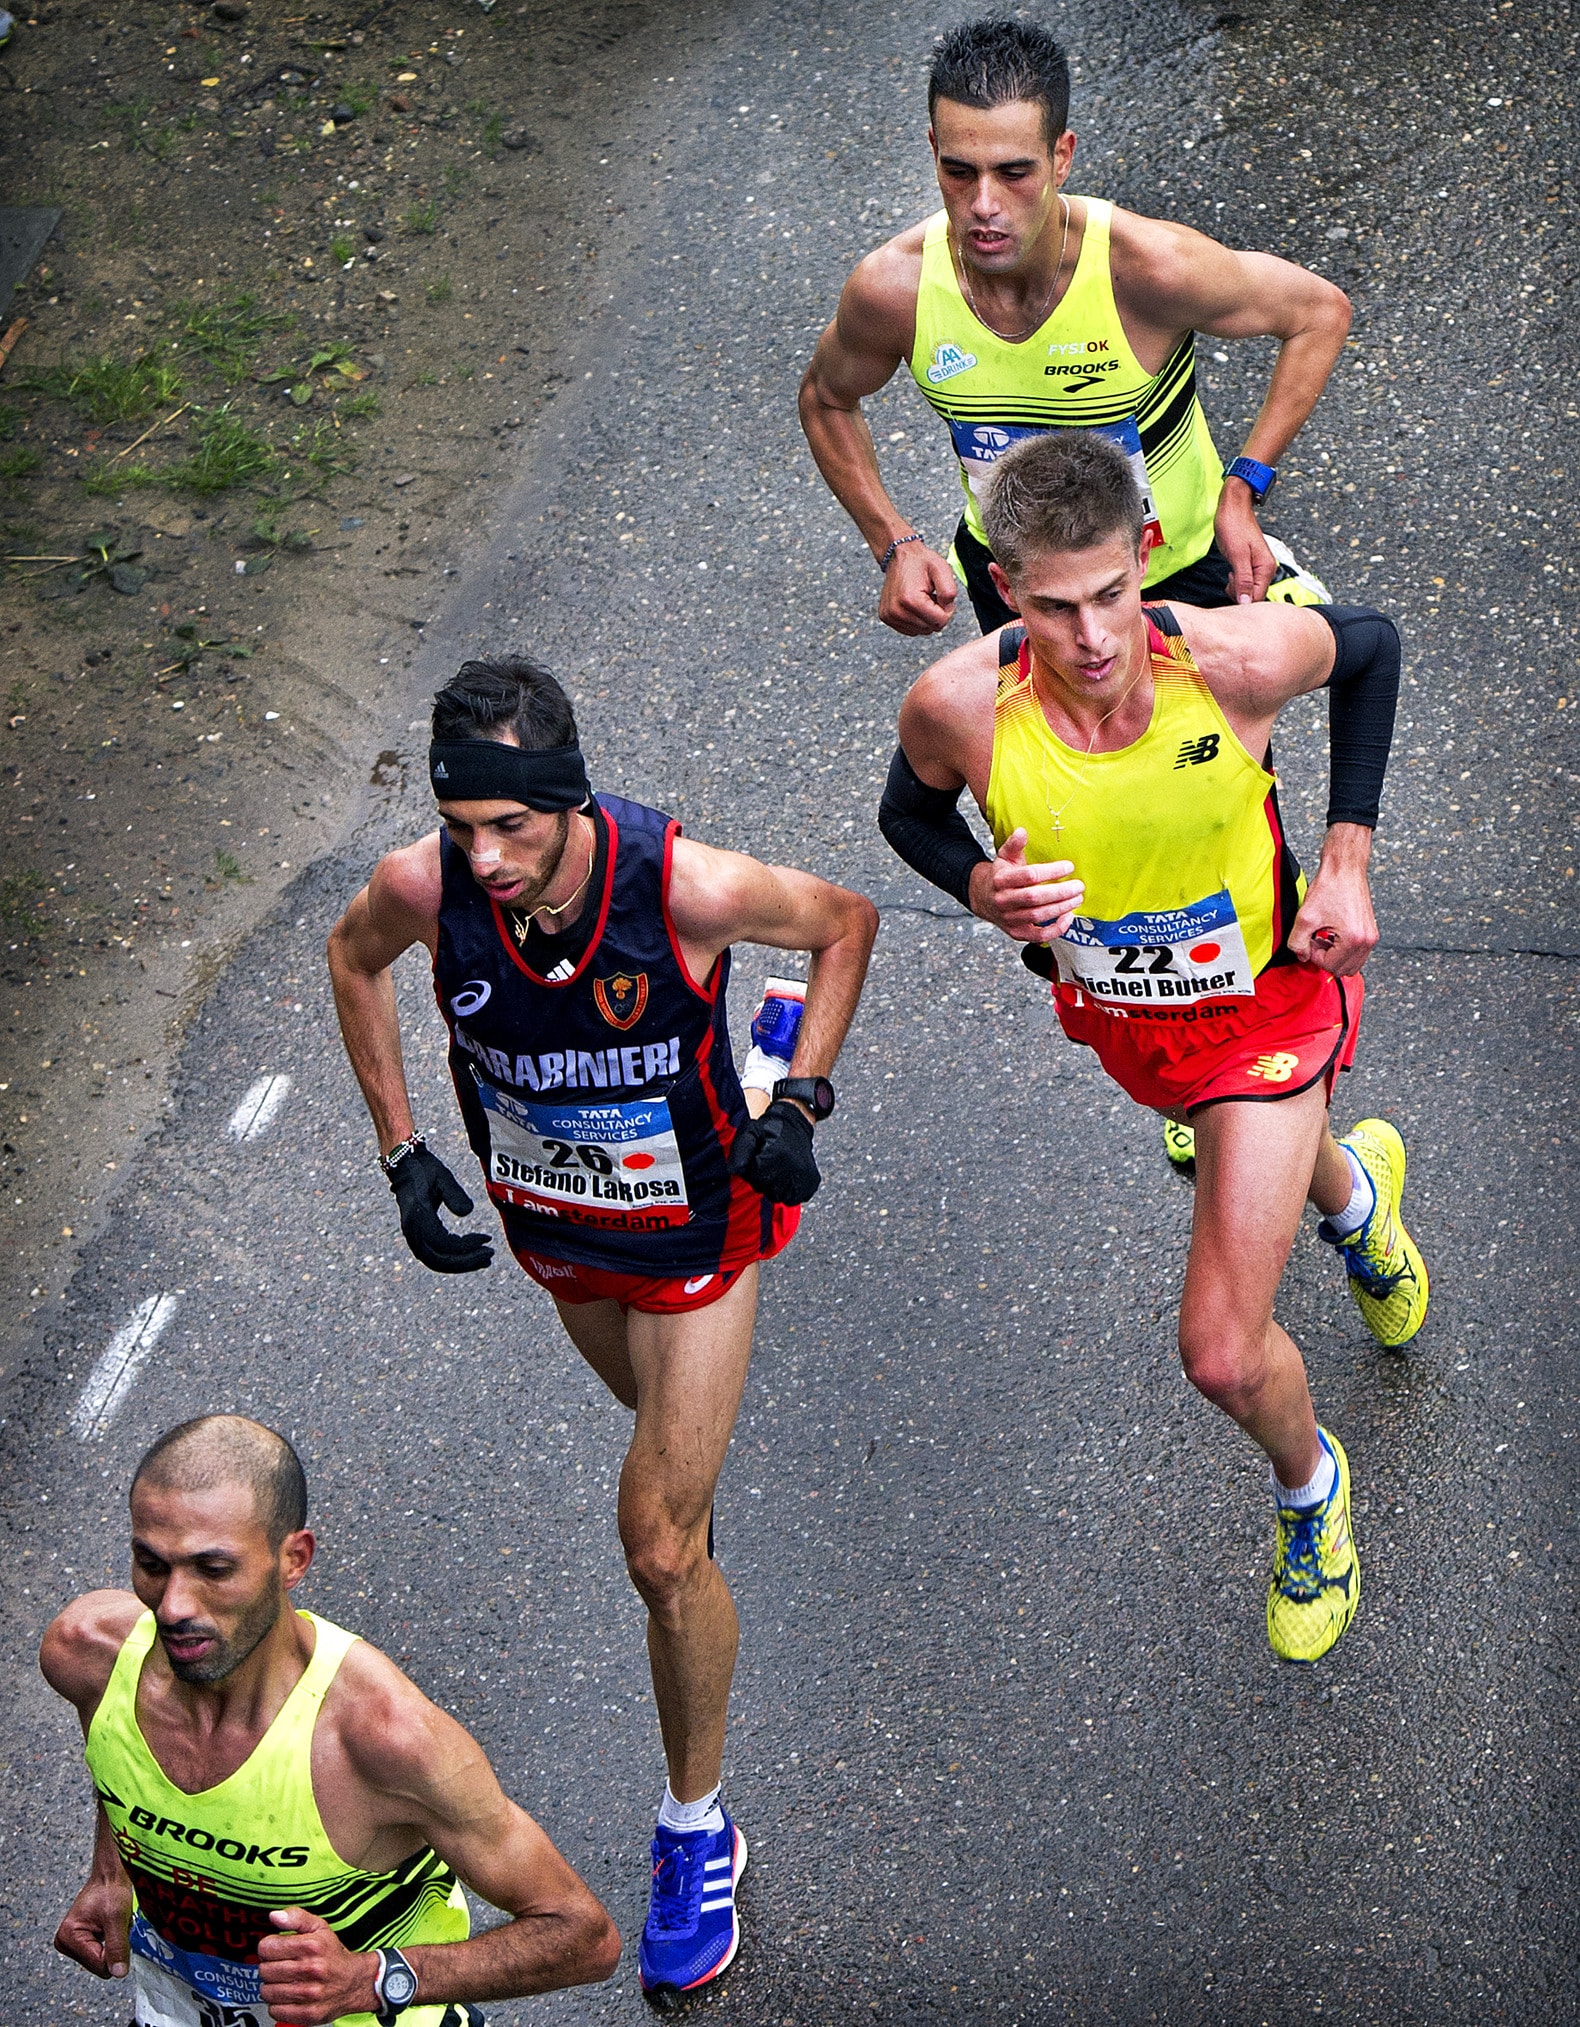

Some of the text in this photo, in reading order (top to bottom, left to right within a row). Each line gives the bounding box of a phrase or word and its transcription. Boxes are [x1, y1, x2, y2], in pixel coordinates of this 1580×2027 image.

[942, 348, 961, 366] AA
[1047, 340, 1109, 357] FYSIOK
[941, 359, 968, 376] DRINK
[1044, 360, 1119, 375] BROOKS
[1118, 909, 1218, 935] CONSULTANCY
[1143, 911, 1189, 924] TATA
[1062, 928, 1105, 947] ATA
[1139, 926, 1204, 945] SERVICES
[1108, 945, 1179, 975] 22
[1157, 971, 1236, 997] Butter
[1075, 989, 1085, 1007] I
[552, 1112, 652, 1130] CONSULTANCY
[578, 1108, 622, 1119] TATA
[573, 1128, 638, 1140] SERVICES
[542, 1140, 613, 1175] 26
[496, 1152, 587, 1196] Stefano
[593, 1174, 680, 1202] LaRosa
[128, 1805, 310, 1867] BROOKS
[172, 1867, 217, 1897] DE
[194, 1970, 263, 1991] CONSULT
